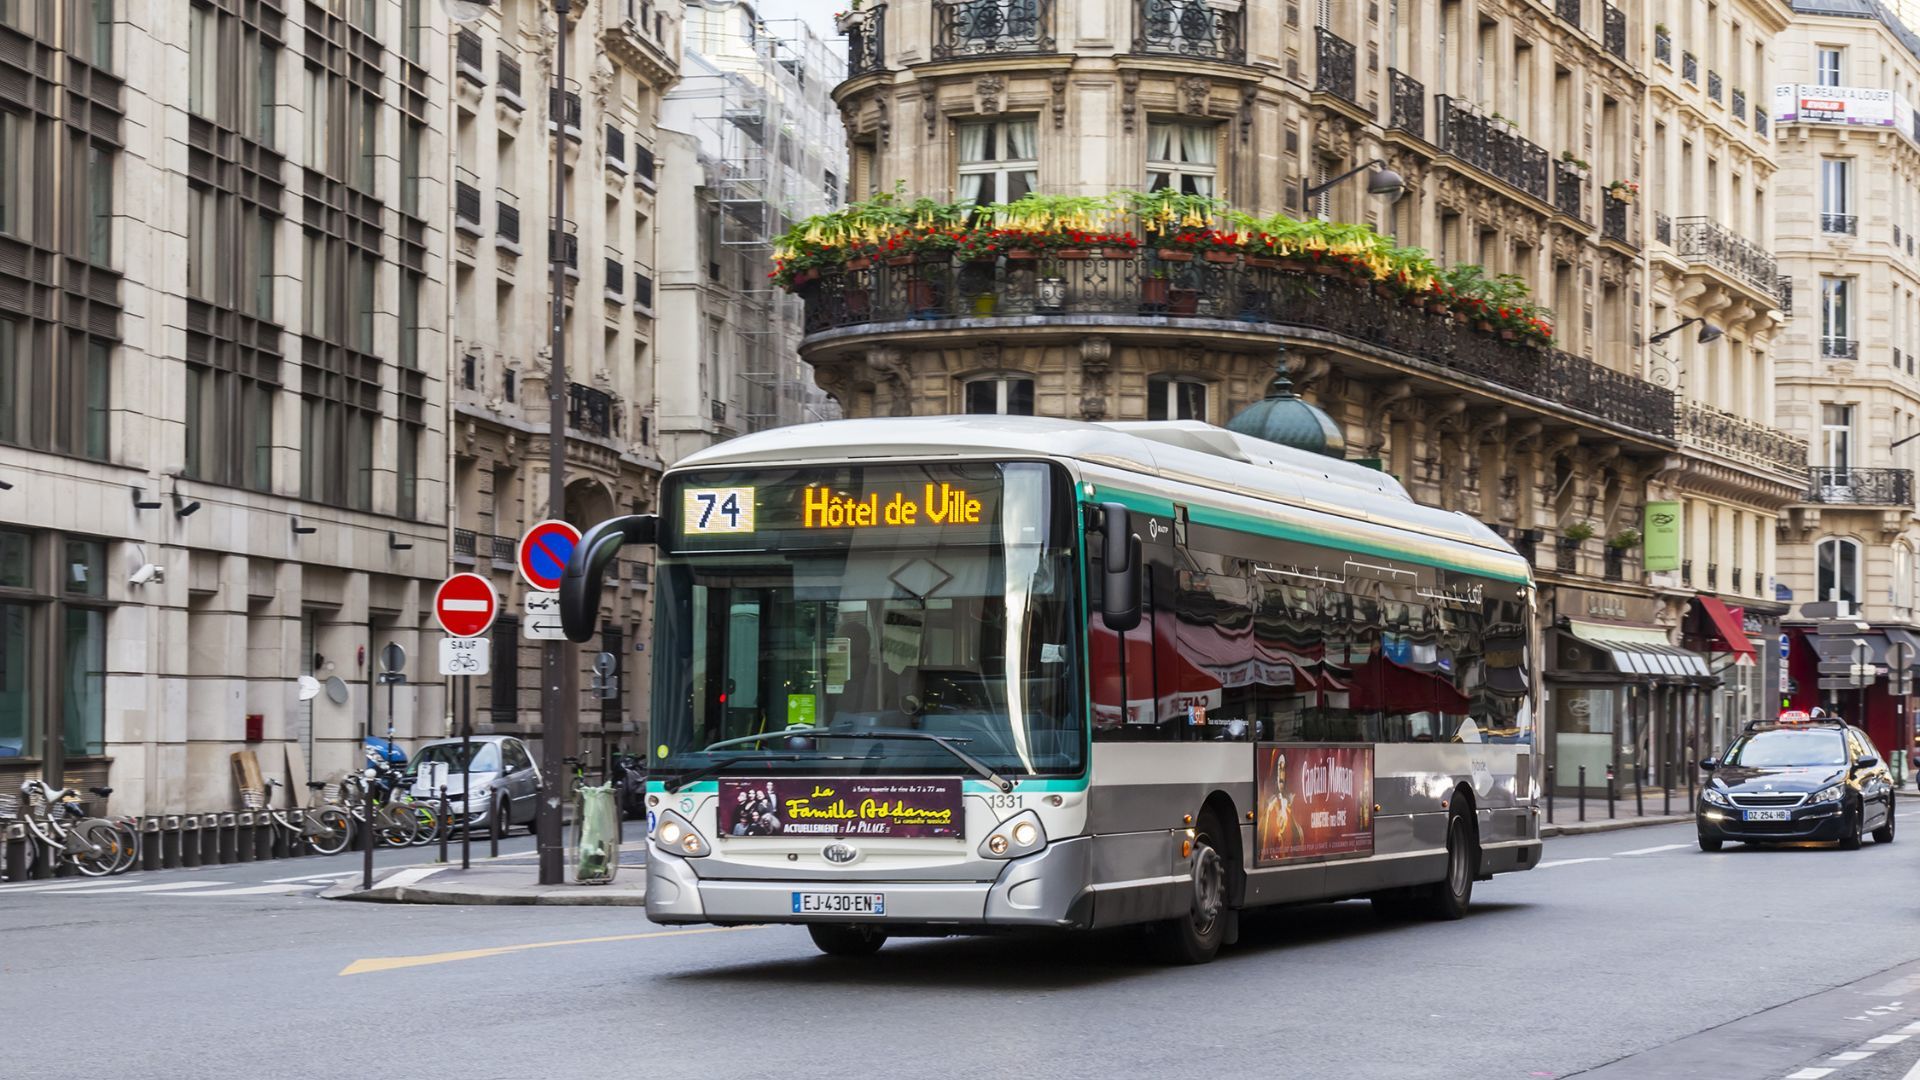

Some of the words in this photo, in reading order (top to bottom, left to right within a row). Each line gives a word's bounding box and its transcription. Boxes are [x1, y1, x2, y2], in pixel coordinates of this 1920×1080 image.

[1801, 86, 1846, 98] BUREAUX
[1858, 90, 1889, 101] LOUER
[696, 493, 740, 529] 74
[804, 487, 877, 528] Hôtel
[885, 493, 917, 526] de
[925, 484, 981, 524] Ville
[451, 640, 477, 650] SAUF
[1302, 759, 1327, 804] Captain
[1325, 757, 1353, 801] Morgan
[811, 785, 835, 798] La
[785, 799, 857, 820] Famille
[859, 799, 952, 820] Addams
[988, 794, 1023, 810] 1331
[783, 823, 839, 834] ACTUELLEMENT
[803, 894, 872, 912] EJ-430-EN
